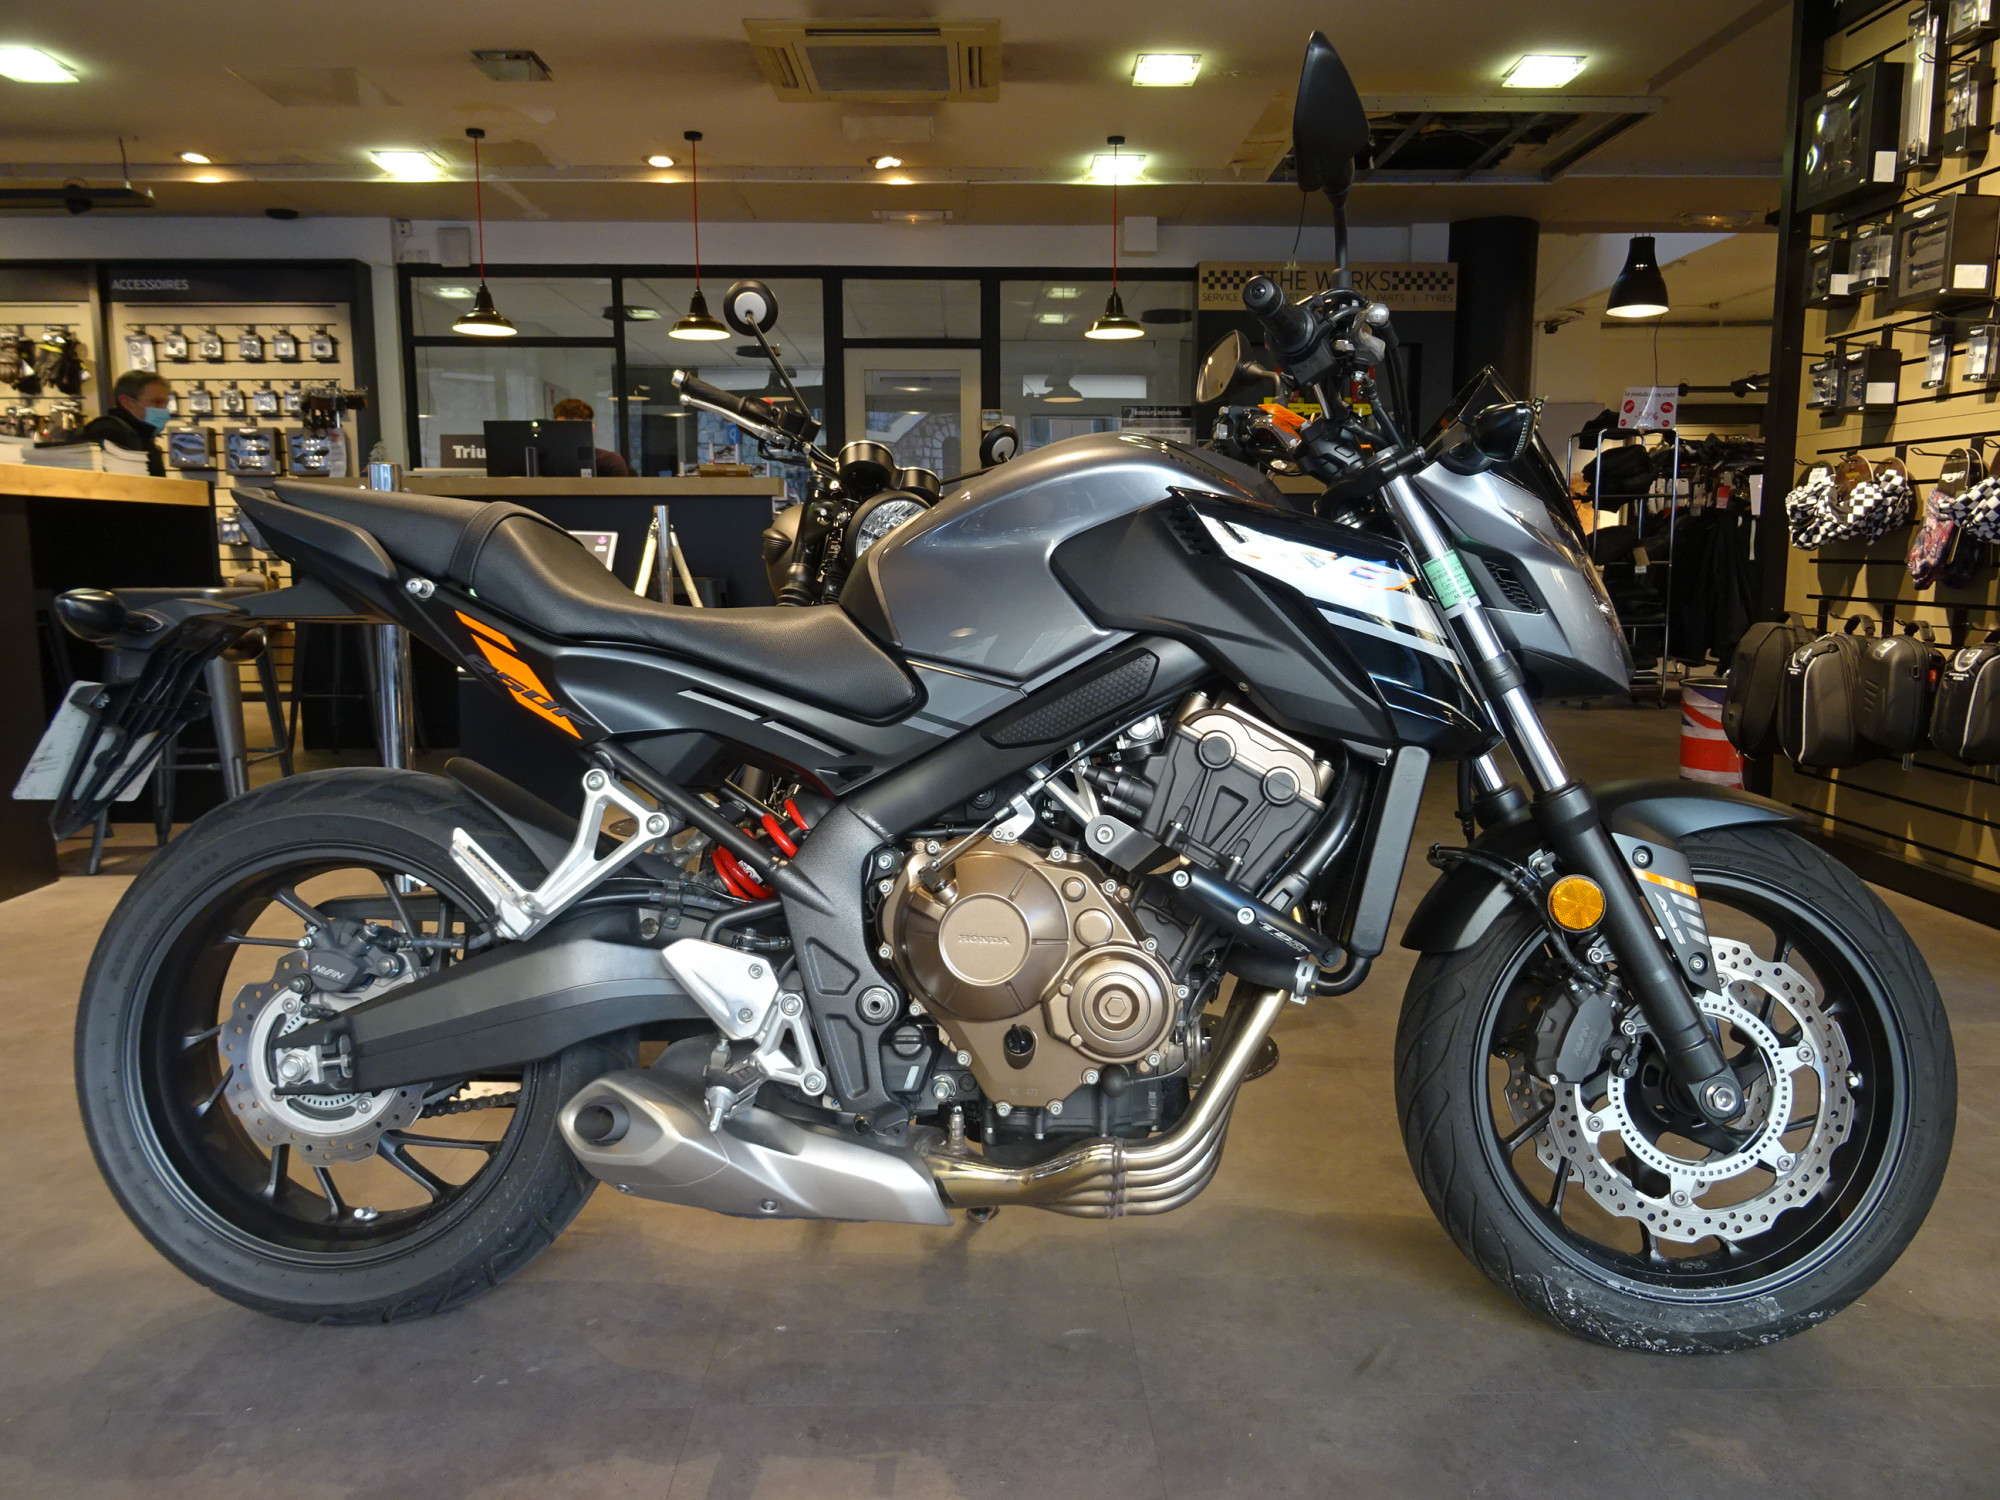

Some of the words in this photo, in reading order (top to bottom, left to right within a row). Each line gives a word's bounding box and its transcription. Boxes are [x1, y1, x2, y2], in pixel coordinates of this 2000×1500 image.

[112, 279, 189, 290] ACCESSOIRES
[1315, 270, 1391, 291] WRKS
[1202, 292, 1239, 302] SERVICE
[452, 444, 487, 459] Triu
[1654, 891, 1687, 945] ABS
[957, 934, 1011, 946] HONDA
